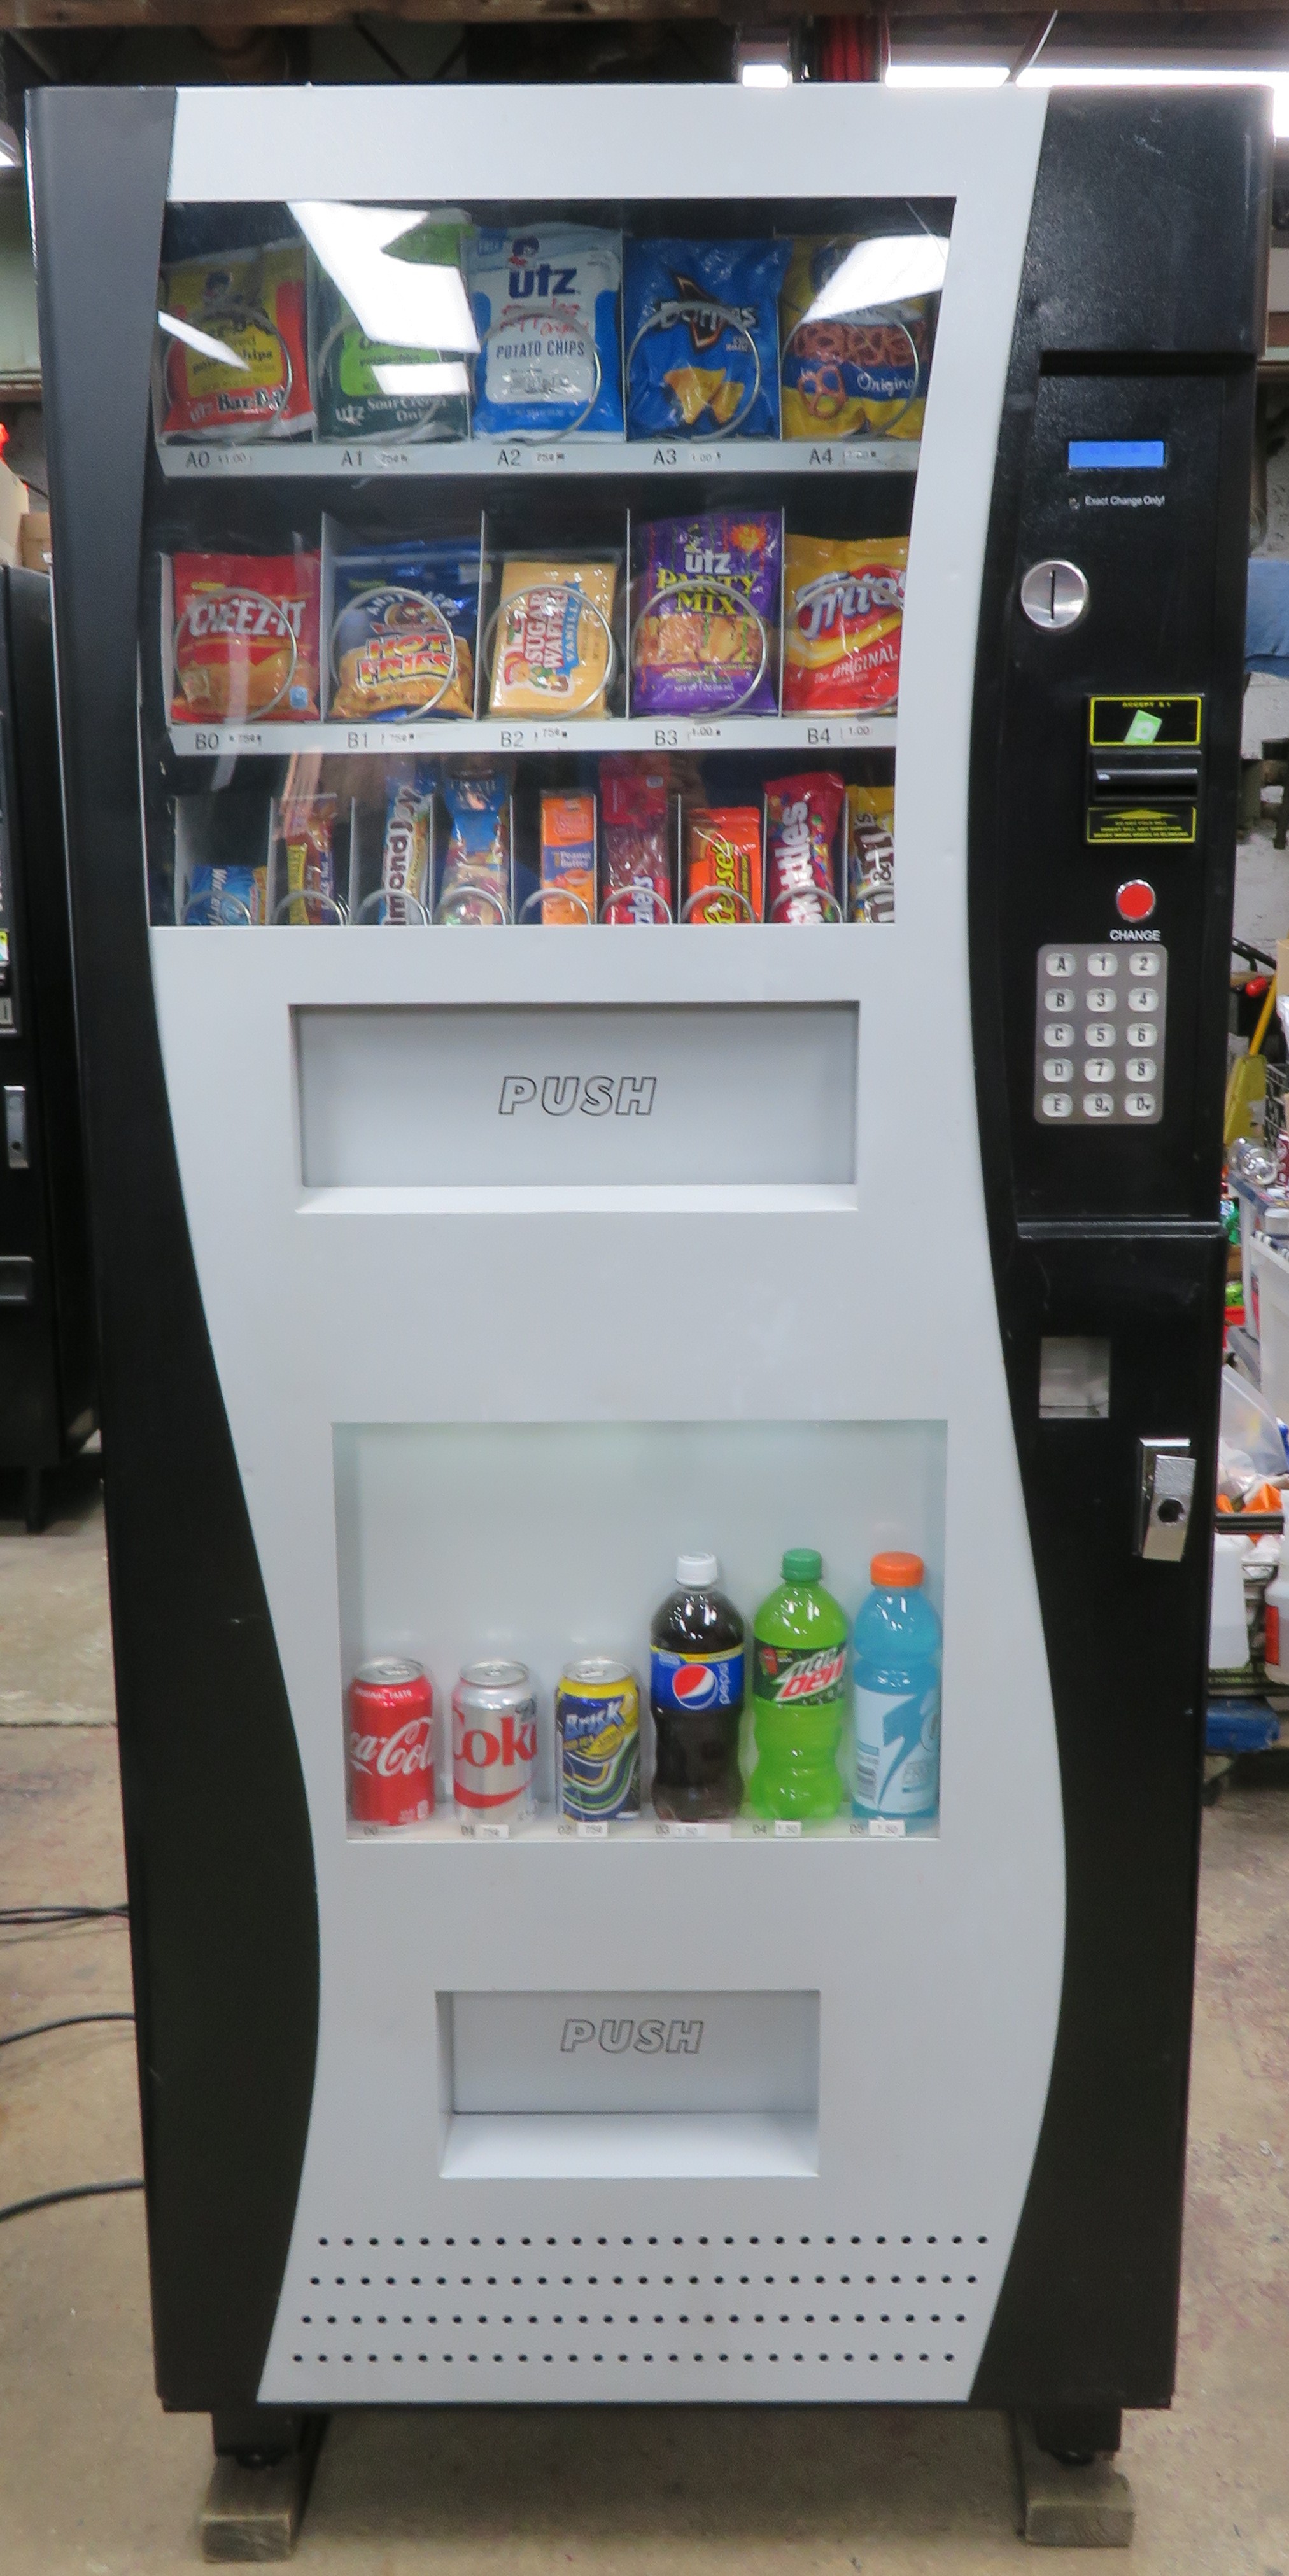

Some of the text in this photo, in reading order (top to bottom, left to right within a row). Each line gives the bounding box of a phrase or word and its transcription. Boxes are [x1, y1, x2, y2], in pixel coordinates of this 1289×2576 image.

[509, 263, 577, 299] utz
[496, 339, 586, 360] POTATO CHIPS
[341, 449, 362, 467] A1
[497, 449, 521, 466] A2
[653, 447, 677, 465] A3
[808, 447, 832, 465] A4
[1110, 495, 1143, 508] Change
[684, 549, 731, 574] utz
[675, 591, 737, 615] MIX
[524, 589, 548, 663] SUGAR
[195, 732, 220, 750] B0
[348, 731, 368, 749] B1
[500, 731, 523, 748] B2
[654, 729, 678, 746] B3
[807, 727, 830, 745] B4
[1109, 929, 1161, 942] CHANGE
[1057, 958, 1066, 972] A
[1100, 958, 1106, 972] 1
[1139, 957, 1148, 971] 2
[1056, 993, 1065, 1007] B
[1097, 993, 1106, 1007] 3
[1139, 993, 1148, 1007] 4
[1055, 1028, 1064, 1042] C
[1096, 1028, 1105, 1042] 5
[1138, 1028, 1146, 1042] 6
[1055, 1063, 1064, 1077] D
[1095, 1063, 1104, 1077] 7
[1137, 1063, 1145, 1077] 8
[498, 1075, 657, 1116] PUSH
[1053, 1098, 1062, 1112] E
[1095, 1098, 1104, 1112] 9
[559, 2018, 704, 2054] PUSH
